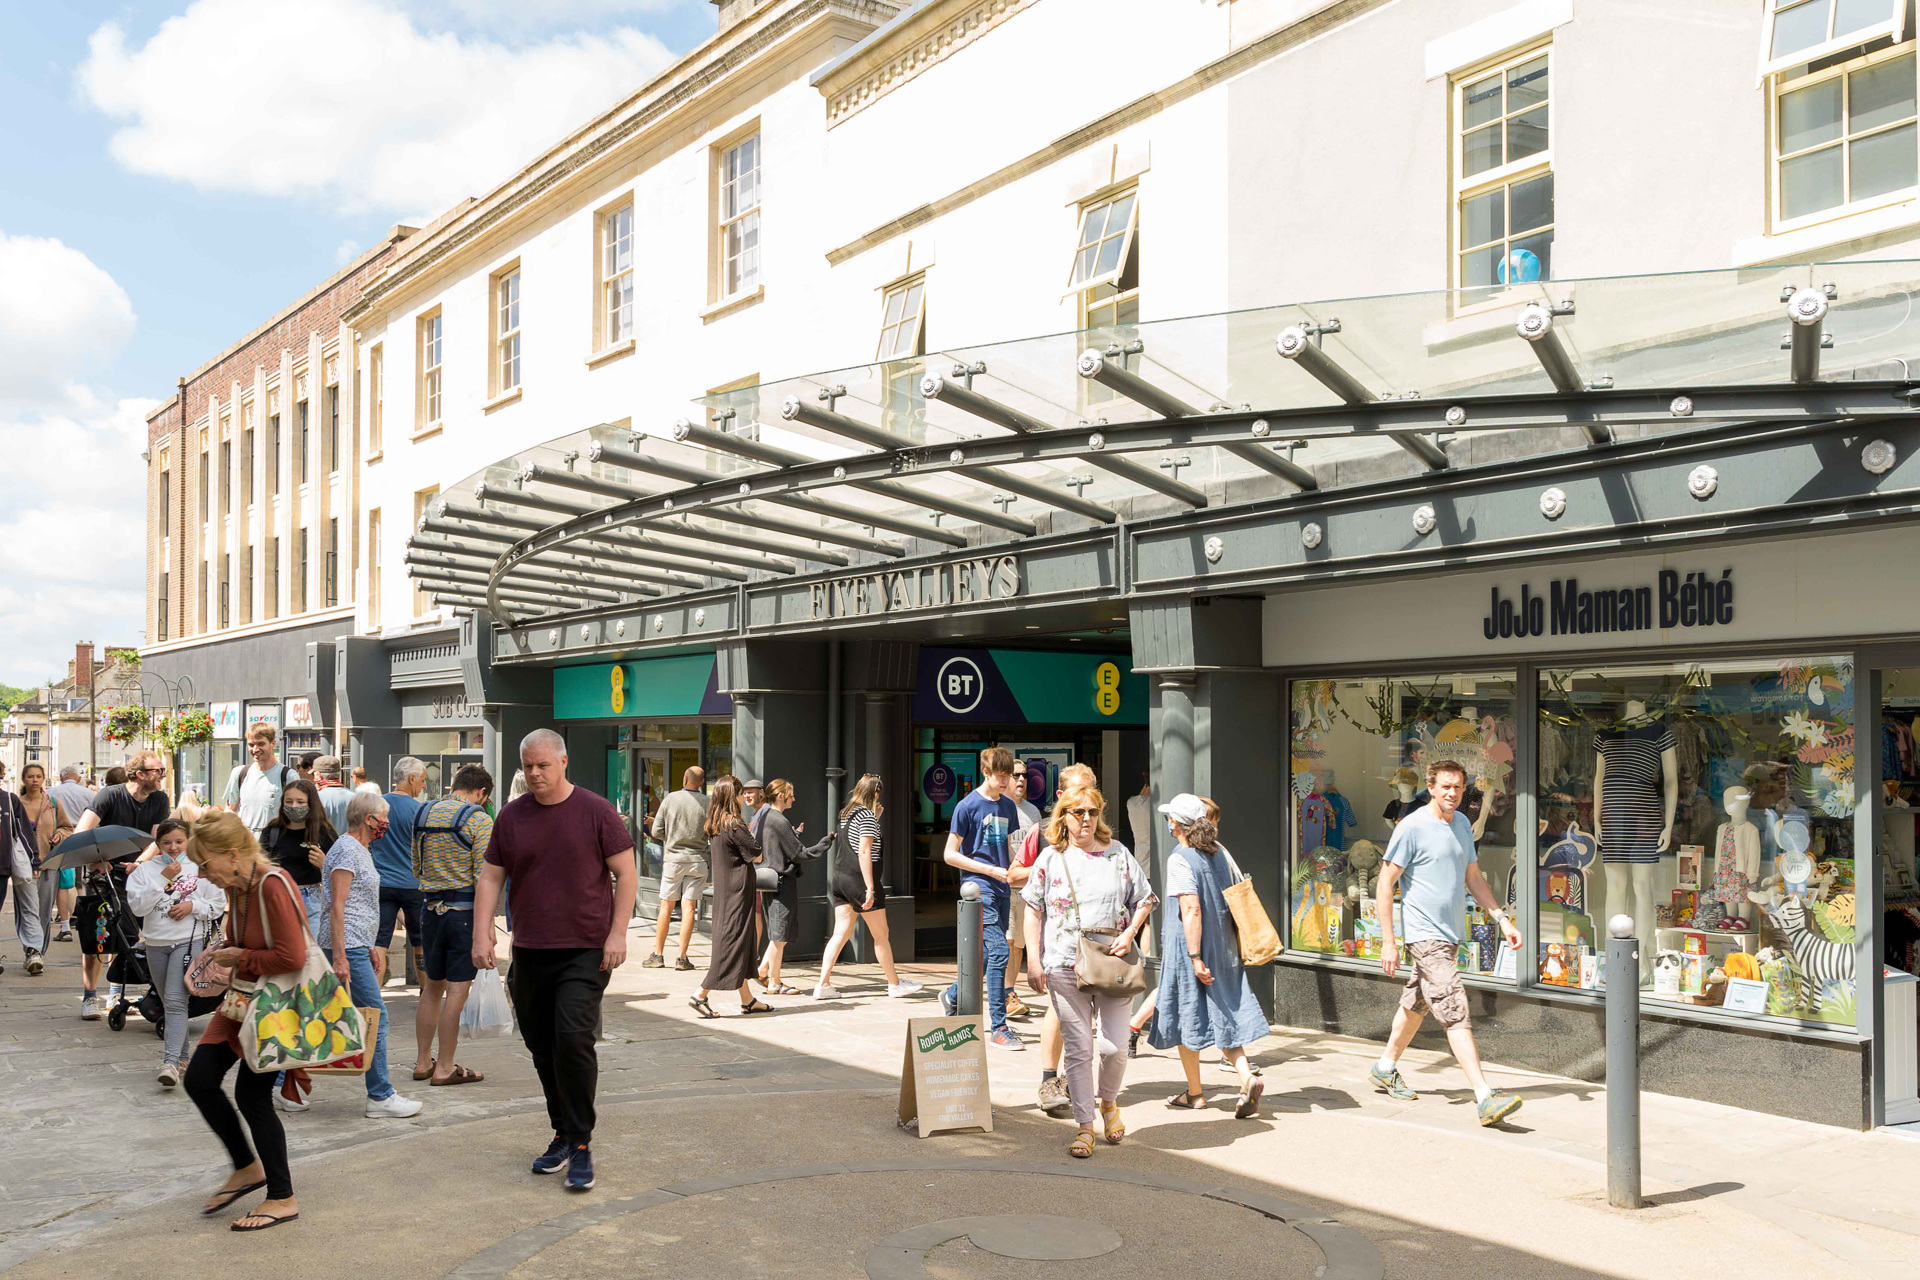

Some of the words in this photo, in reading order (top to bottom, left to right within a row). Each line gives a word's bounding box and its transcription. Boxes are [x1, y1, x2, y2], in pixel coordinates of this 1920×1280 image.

[809, 576, 870, 620] FIVE
[874, 555, 1021, 612] VALLEYS
[1483, 584, 1544, 640] JoJo
[1550, 579, 1652, 636] Maman
[1658, 568, 1733, 629] Bébé
[948, 674, 974, 696] BT
[432, 695, 453, 719] SUB
[249, 713, 278, 722] savers
[1438, 748, 1454, 757] Walk
[1466, 748, 1478, 756] the
[1459, 756, 1485, 774] Side
[1786, 865, 1804, 874] VIP
[919, 1030, 945, 1050] ROUGH
[947, 1028, 972, 1046] HANDS
[924, 1059, 957, 1071] SPECIALITY
[957, 1058, 979, 1068] COFFEE
[960, 1072, 980, 1082] CAKES
